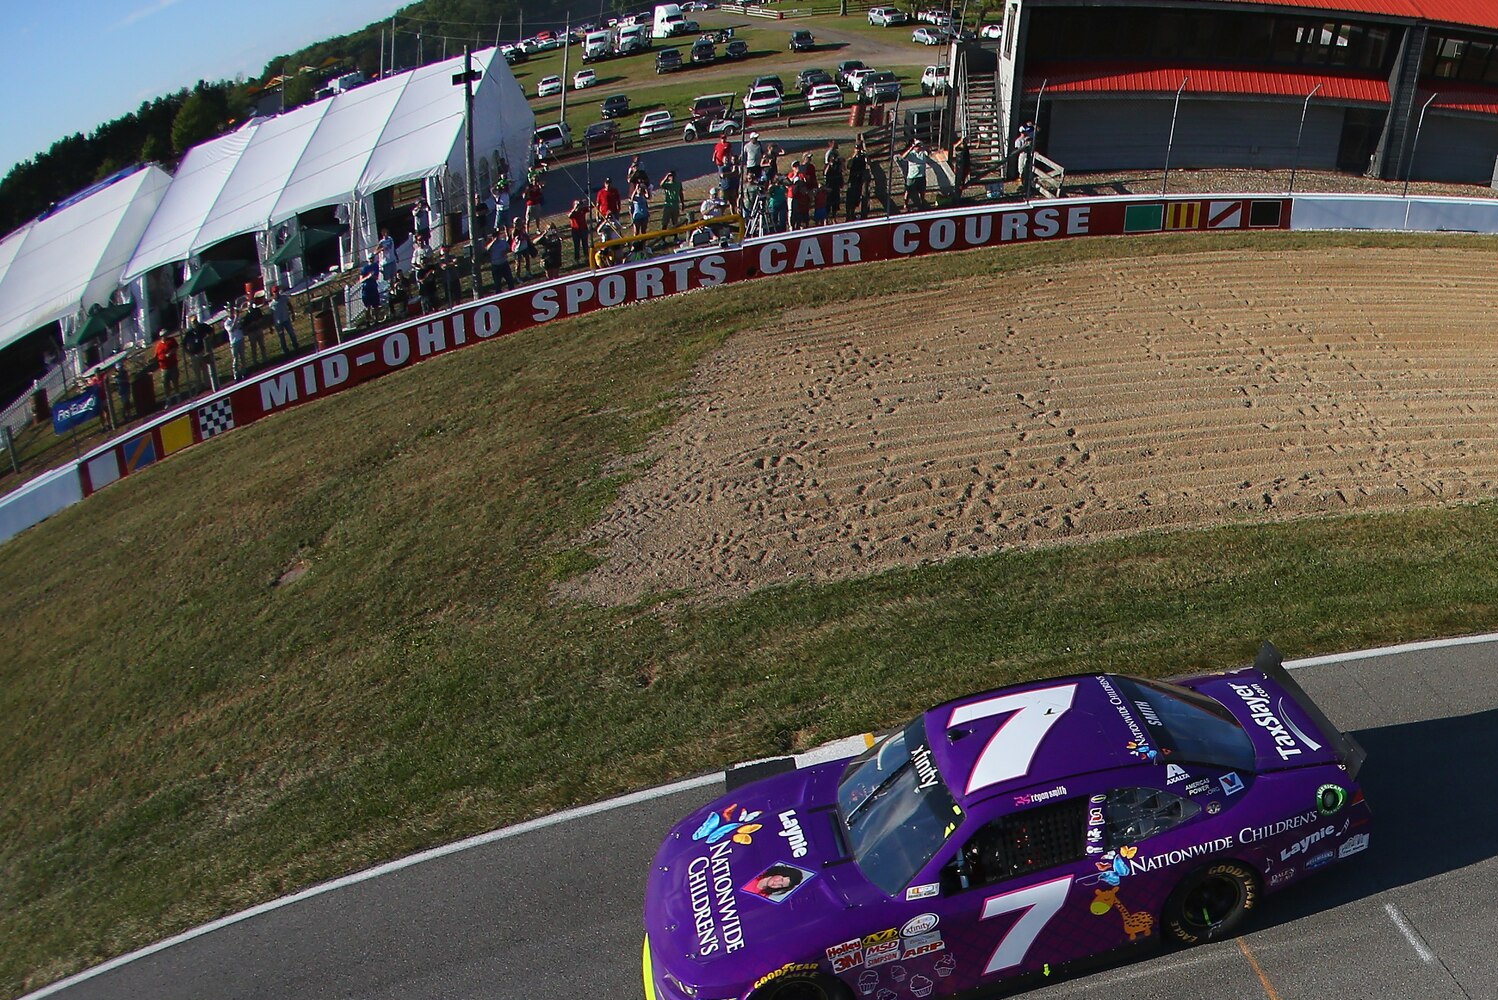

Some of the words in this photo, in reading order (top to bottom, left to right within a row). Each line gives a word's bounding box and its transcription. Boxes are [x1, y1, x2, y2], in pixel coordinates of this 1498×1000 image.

[259, 304, 501, 411] MID-OHIO
[532, 255, 727, 322] SPORTS
[759, 233, 861, 274] CAR
[892, 206, 1091, 254] COURSE
[1134, 700, 1163, 726] SMITH
[1227, 682, 1302, 761] TaxSlayer
[947, 682, 1079, 797] 7
[911, 744, 939, 789] xfinity
[1166, 773, 1191, 786] AXALTA
[778, 809, 809, 859] Laynie
[1130, 836, 1234, 876] NATIONWIDE
[1239, 810, 1318, 844] CHILDREN'S
[1280, 825, 1335, 861] Laynie
[688, 856, 720, 956] CHILDREN'S
[709, 839, 746, 954] NATIONWIDE
[867, 940, 899, 957] MSD
[979, 874, 1075, 977] 7
[827, 941, 861, 958] Holley
[834, 951, 862, 973] 3M
[902, 941, 944, 960] ARP
